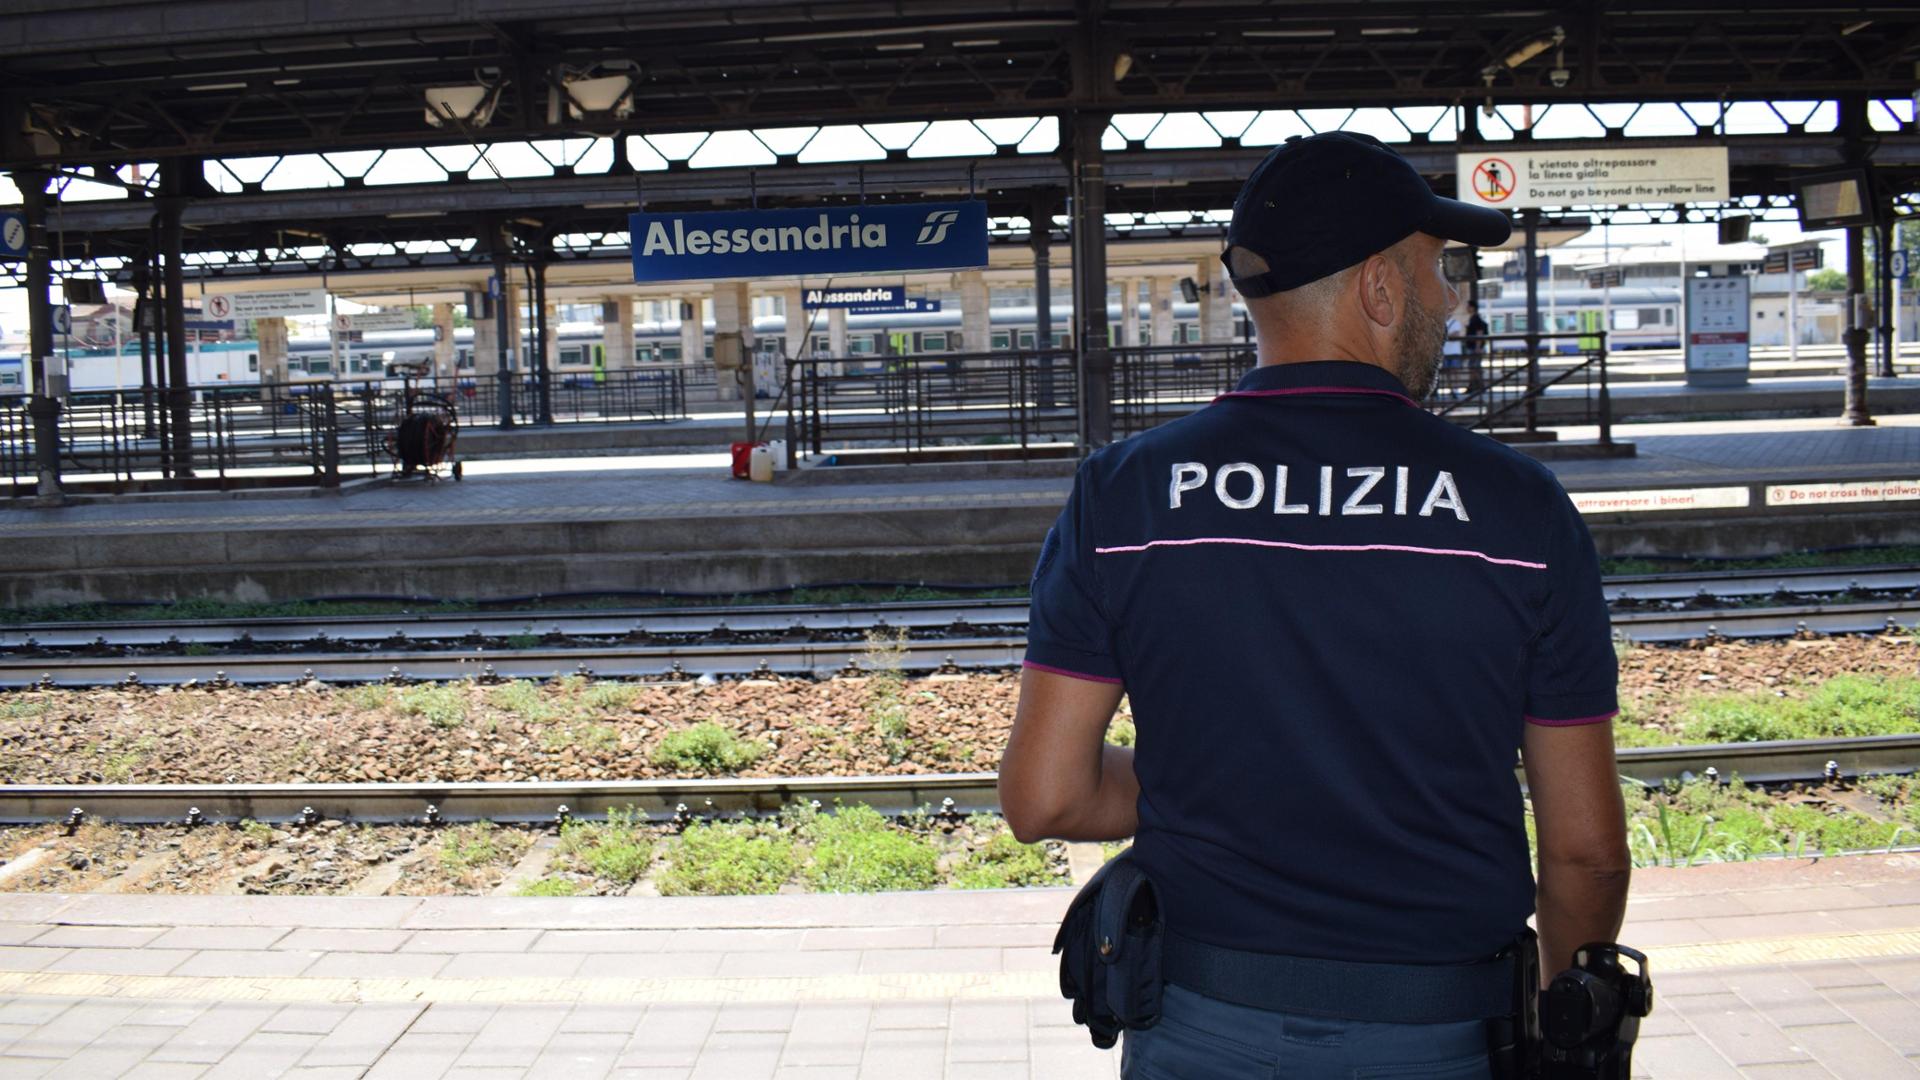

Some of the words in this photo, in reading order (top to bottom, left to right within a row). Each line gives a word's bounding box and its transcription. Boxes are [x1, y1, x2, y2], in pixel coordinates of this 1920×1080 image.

[1539, 158, 1580, 169] vietato
[1582, 157, 1657, 169] oltrepassare
[1528, 170, 1540, 180] la
[1543, 169, 1573, 180] linea
[1576, 168, 1610, 181] gialla
[1529, 188, 1545, 198] Do
[1547, 187, 1567, 198] not
[1570, 188, 1585, 199] go
[1587, 185, 1633, 198] beyond
[1634, 185, 1654, 196] the
[1656, 183, 1693, 197] yellow
[1695, 183, 1716, 194] line
[642, 213, 888, 257] Alessandria
[1169, 461, 1470, 522] POLIZIA
[1789, 490, 1805, 500] Do
[1808, 489, 1827, 499] not
[1830, 488, 1858, 499] cross
[1861, 486, 1879, 497] the
[1576, 497, 1650, 508] attraversare
[1659, 494, 1695, 505] binari
